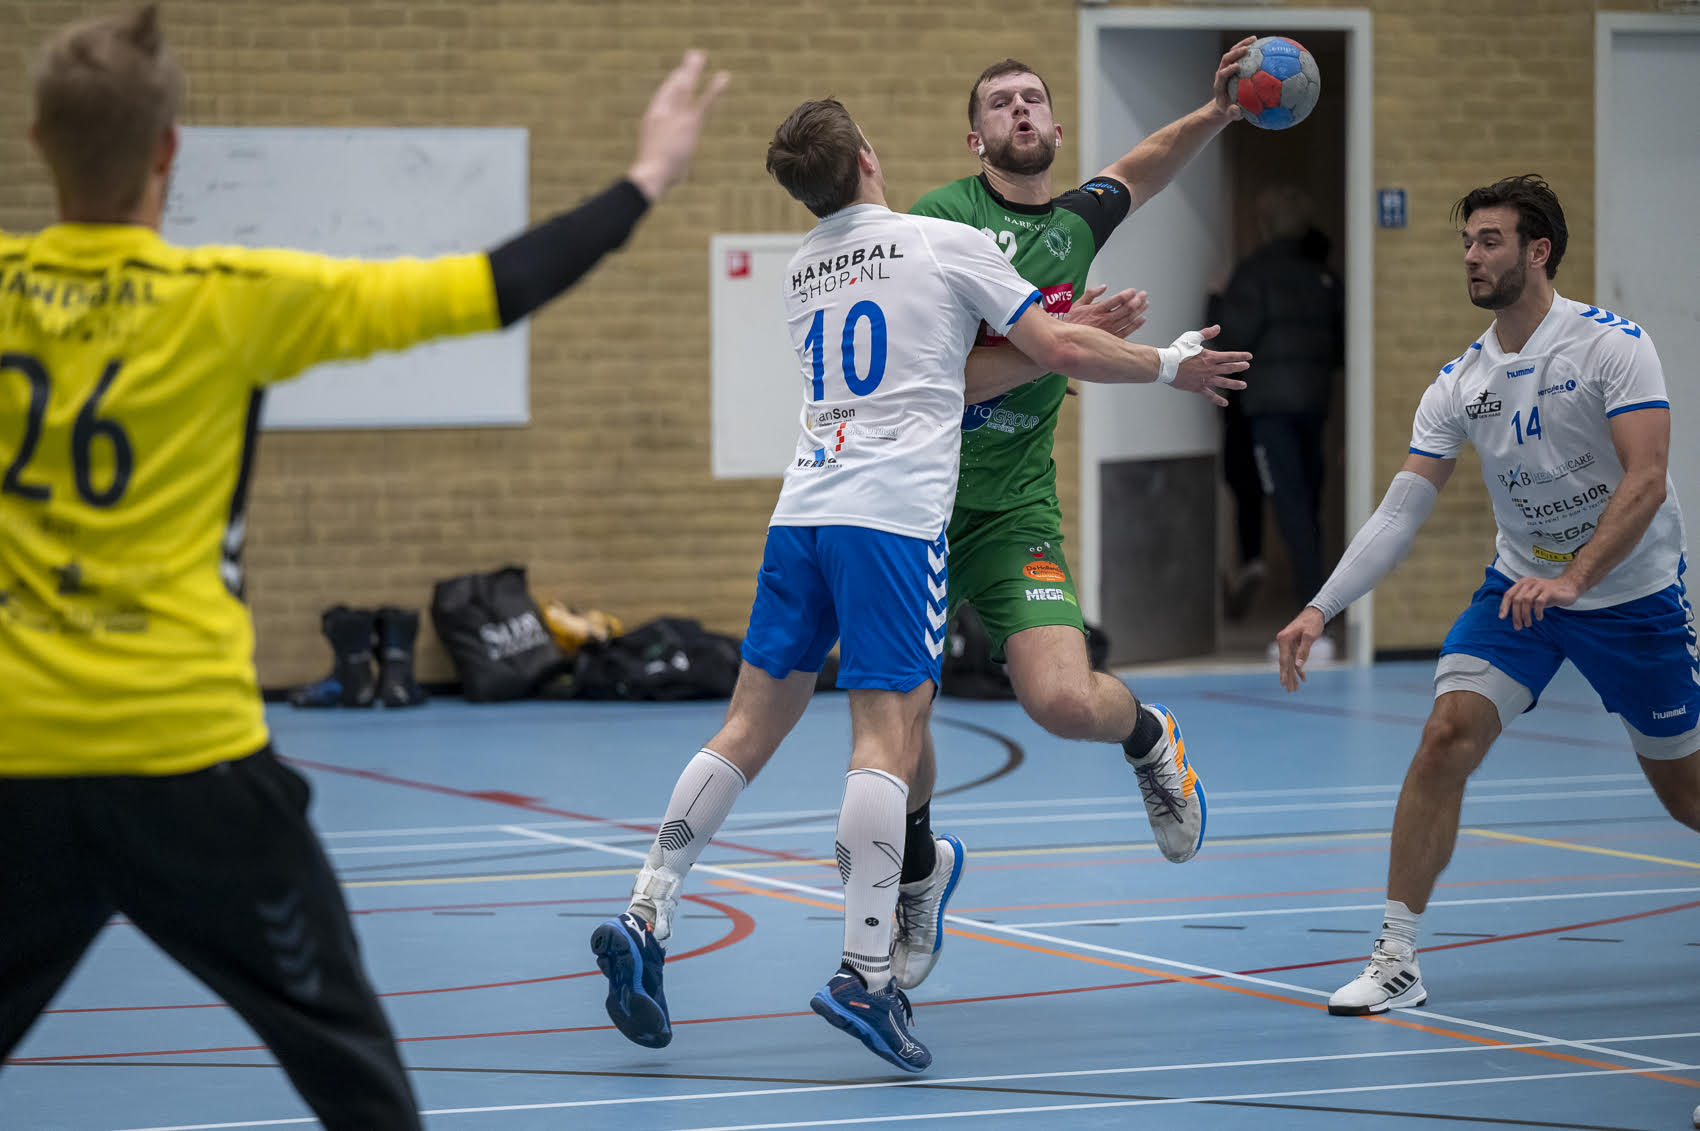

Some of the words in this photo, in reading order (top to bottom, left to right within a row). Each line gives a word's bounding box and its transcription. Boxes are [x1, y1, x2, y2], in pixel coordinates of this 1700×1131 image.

[792, 243, 904, 291] HANDBAL
[0, 270, 158, 309] ANDBAL
[804, 300, 887, 402] 10
[816, 408, 856, 422] anSon
[993, 408, 1040, 429] GROUP
[1467, 402, 1500, 416] WHC
[1511, 405, 1542, 445] 14
[0, 351, 134, 510] 26
[1533, 451, 1594, 481] HEALTHCARE
[1652, 704, 1687, 720] hummel
